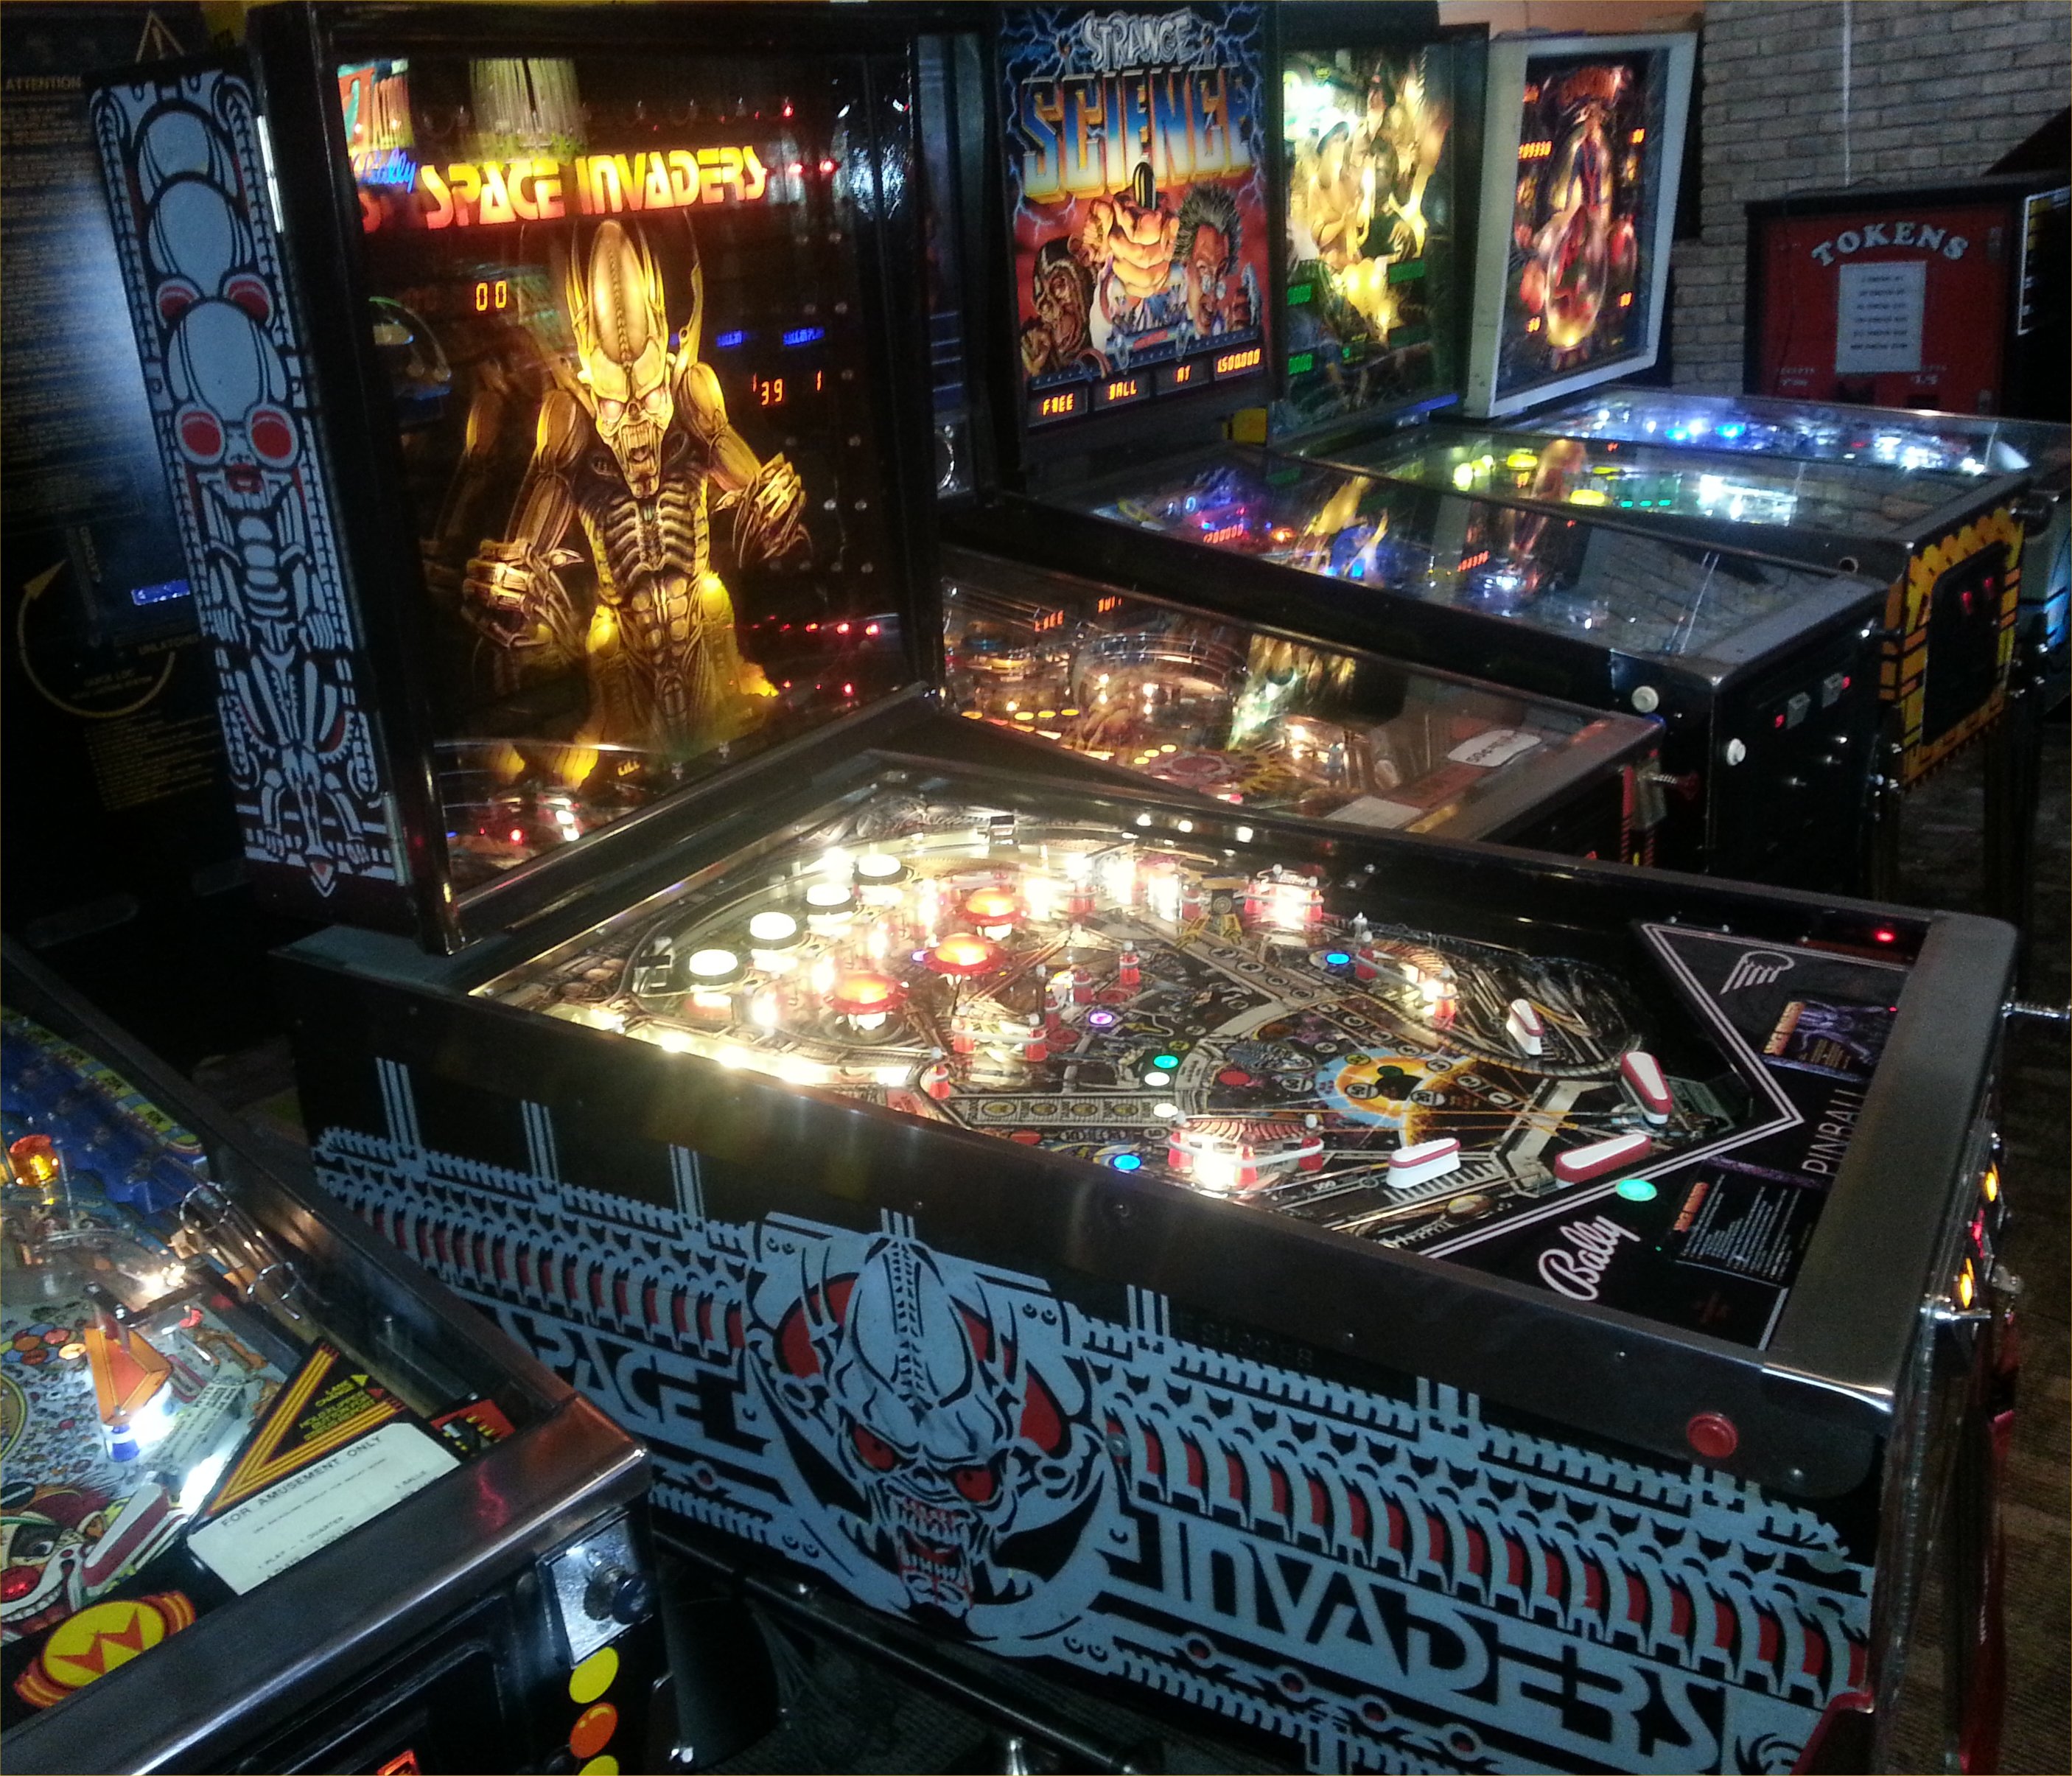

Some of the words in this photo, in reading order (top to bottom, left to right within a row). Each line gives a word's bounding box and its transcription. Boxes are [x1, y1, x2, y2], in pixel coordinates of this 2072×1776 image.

[1081, 7, 1193, 71] STRANGE
[6, 75, 81, 91] ATTENTION
[1021, 63, 1253, 203] SCIENCE
[421, 157, 566, 229] SPACE
[575, 146, 766, 214] INVADERS
[1811, 221, 1969, 266] TOKENS
[1042, 394, 1074, 416] FREE
[1109, 380, 1137, 399] BALL
[1539, 1214, 1641, 1301] Bally
[221, 1507, 251, 1528] FOR
[258, 1458, 339, 1506] AMUSEMENT
[347, 1436, 382, 1457] ONLY
[1160, 1509, 1726, 1769] INVADERS
